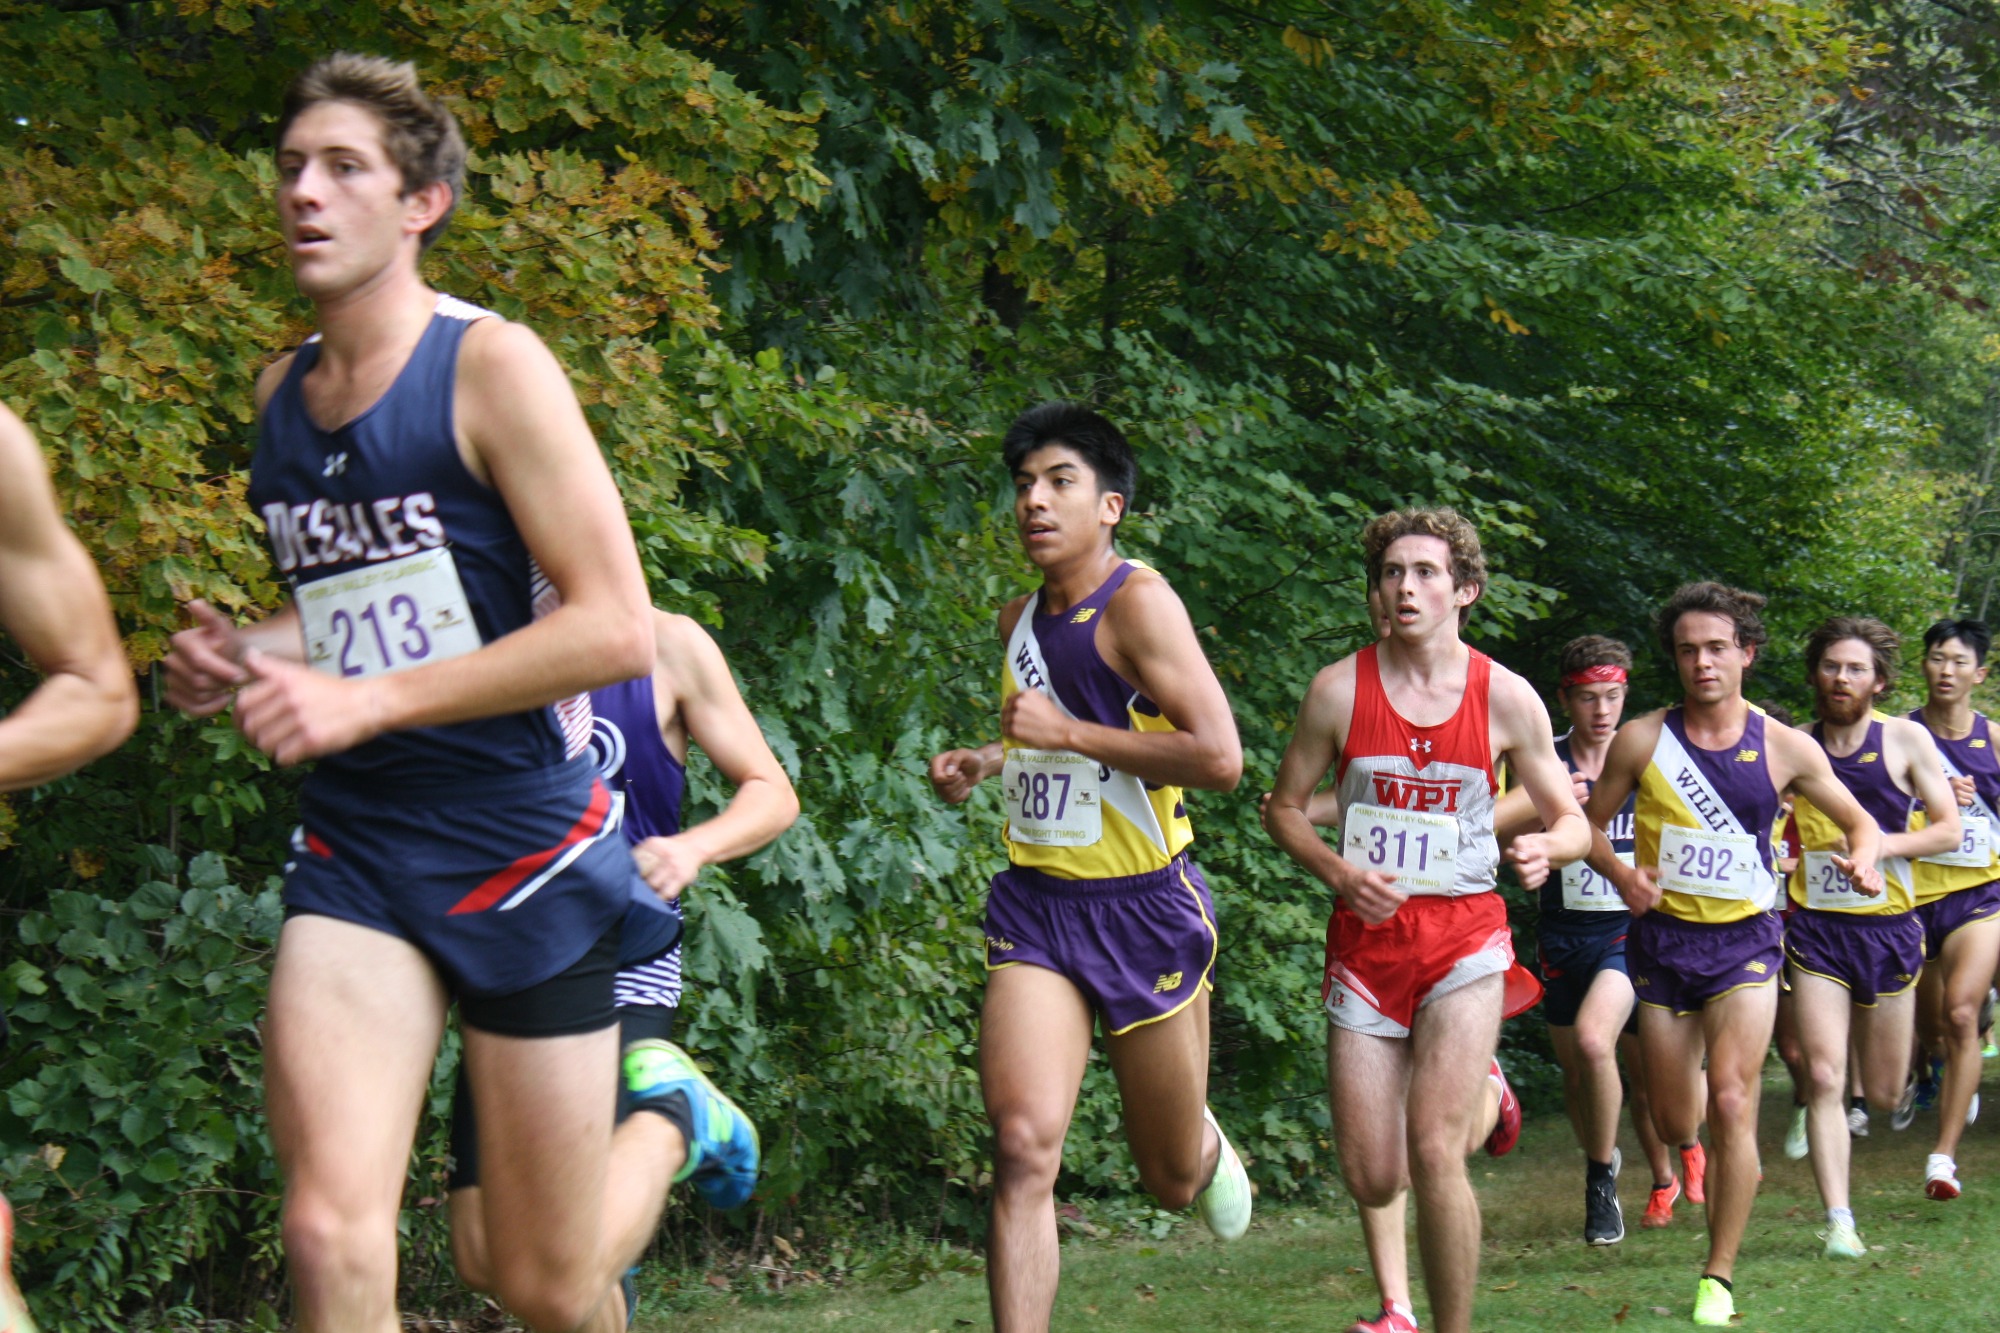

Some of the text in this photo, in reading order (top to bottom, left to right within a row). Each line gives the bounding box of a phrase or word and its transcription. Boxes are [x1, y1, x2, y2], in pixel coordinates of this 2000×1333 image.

[332, 593, 431, 678] 213
[1018, 771, 1072, 820] 287
[1372, 778, 1461, 813] WPI
[1676, 766, 1736, 833] WILLI
[1355, 806, 1384, 818] PURPLE
[1385, 812, 1415, 823] VALLEY
[1368, 825, 1429, 871] 311
[1678, 844, 1734, 881] 292
[1411, 876, 1442, 888] TIMING
[1821, 865, 1852, 894] 29
